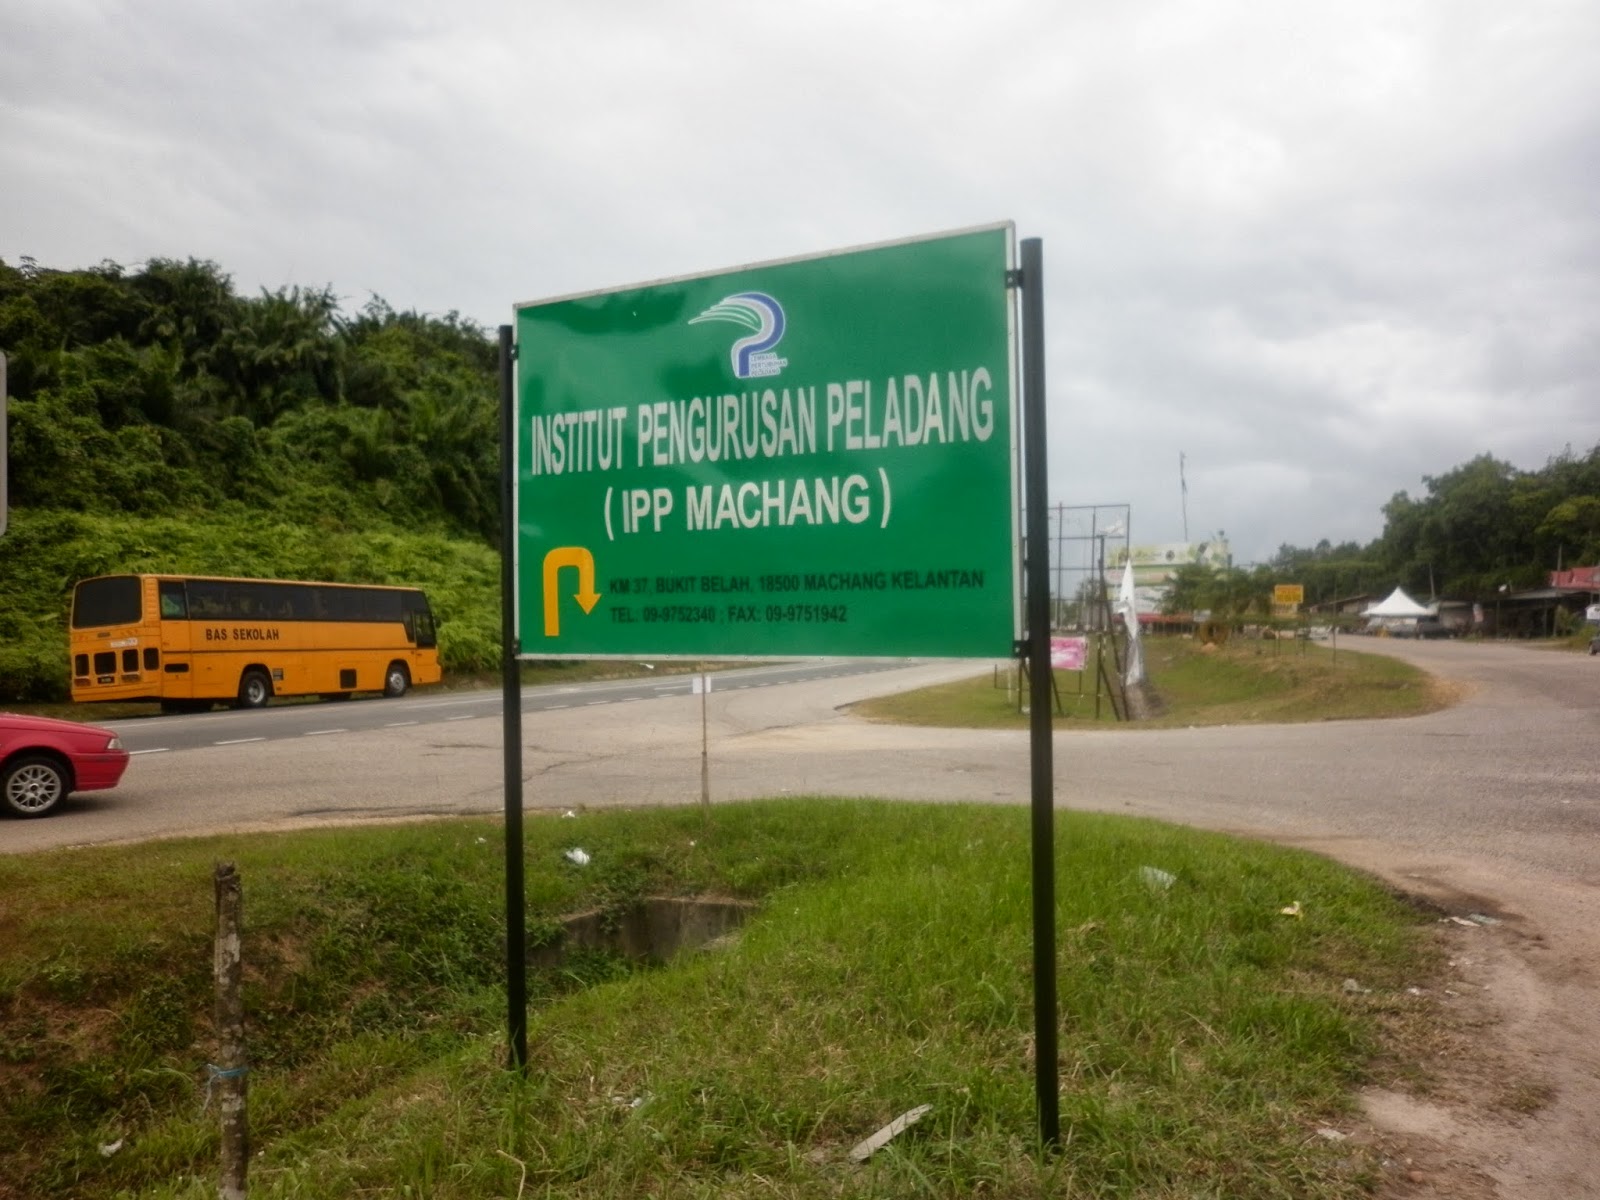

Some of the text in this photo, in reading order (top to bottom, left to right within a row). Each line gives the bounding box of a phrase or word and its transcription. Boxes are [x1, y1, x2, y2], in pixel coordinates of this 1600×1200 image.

[531, 366, 994, 476] INSTITUT PENGURUSAN PELADANG
[622, 488, 674, 533] IPP
[686, 474, 870, 531] MACHANG
[609, 577, 631, 594] KM
[655, 575, 697, 593] BUKIT
[759, 573, 799, 592] 18500
[803, 572, 887, 591] MACHANG
[891, 569, 984, 589] KELANTAN
[642, 605, 716, 623] 09-9752340
[765, 603, 848, 622] 09-9751942
[205, 628, 280, 641] BAS SEKOLAH
